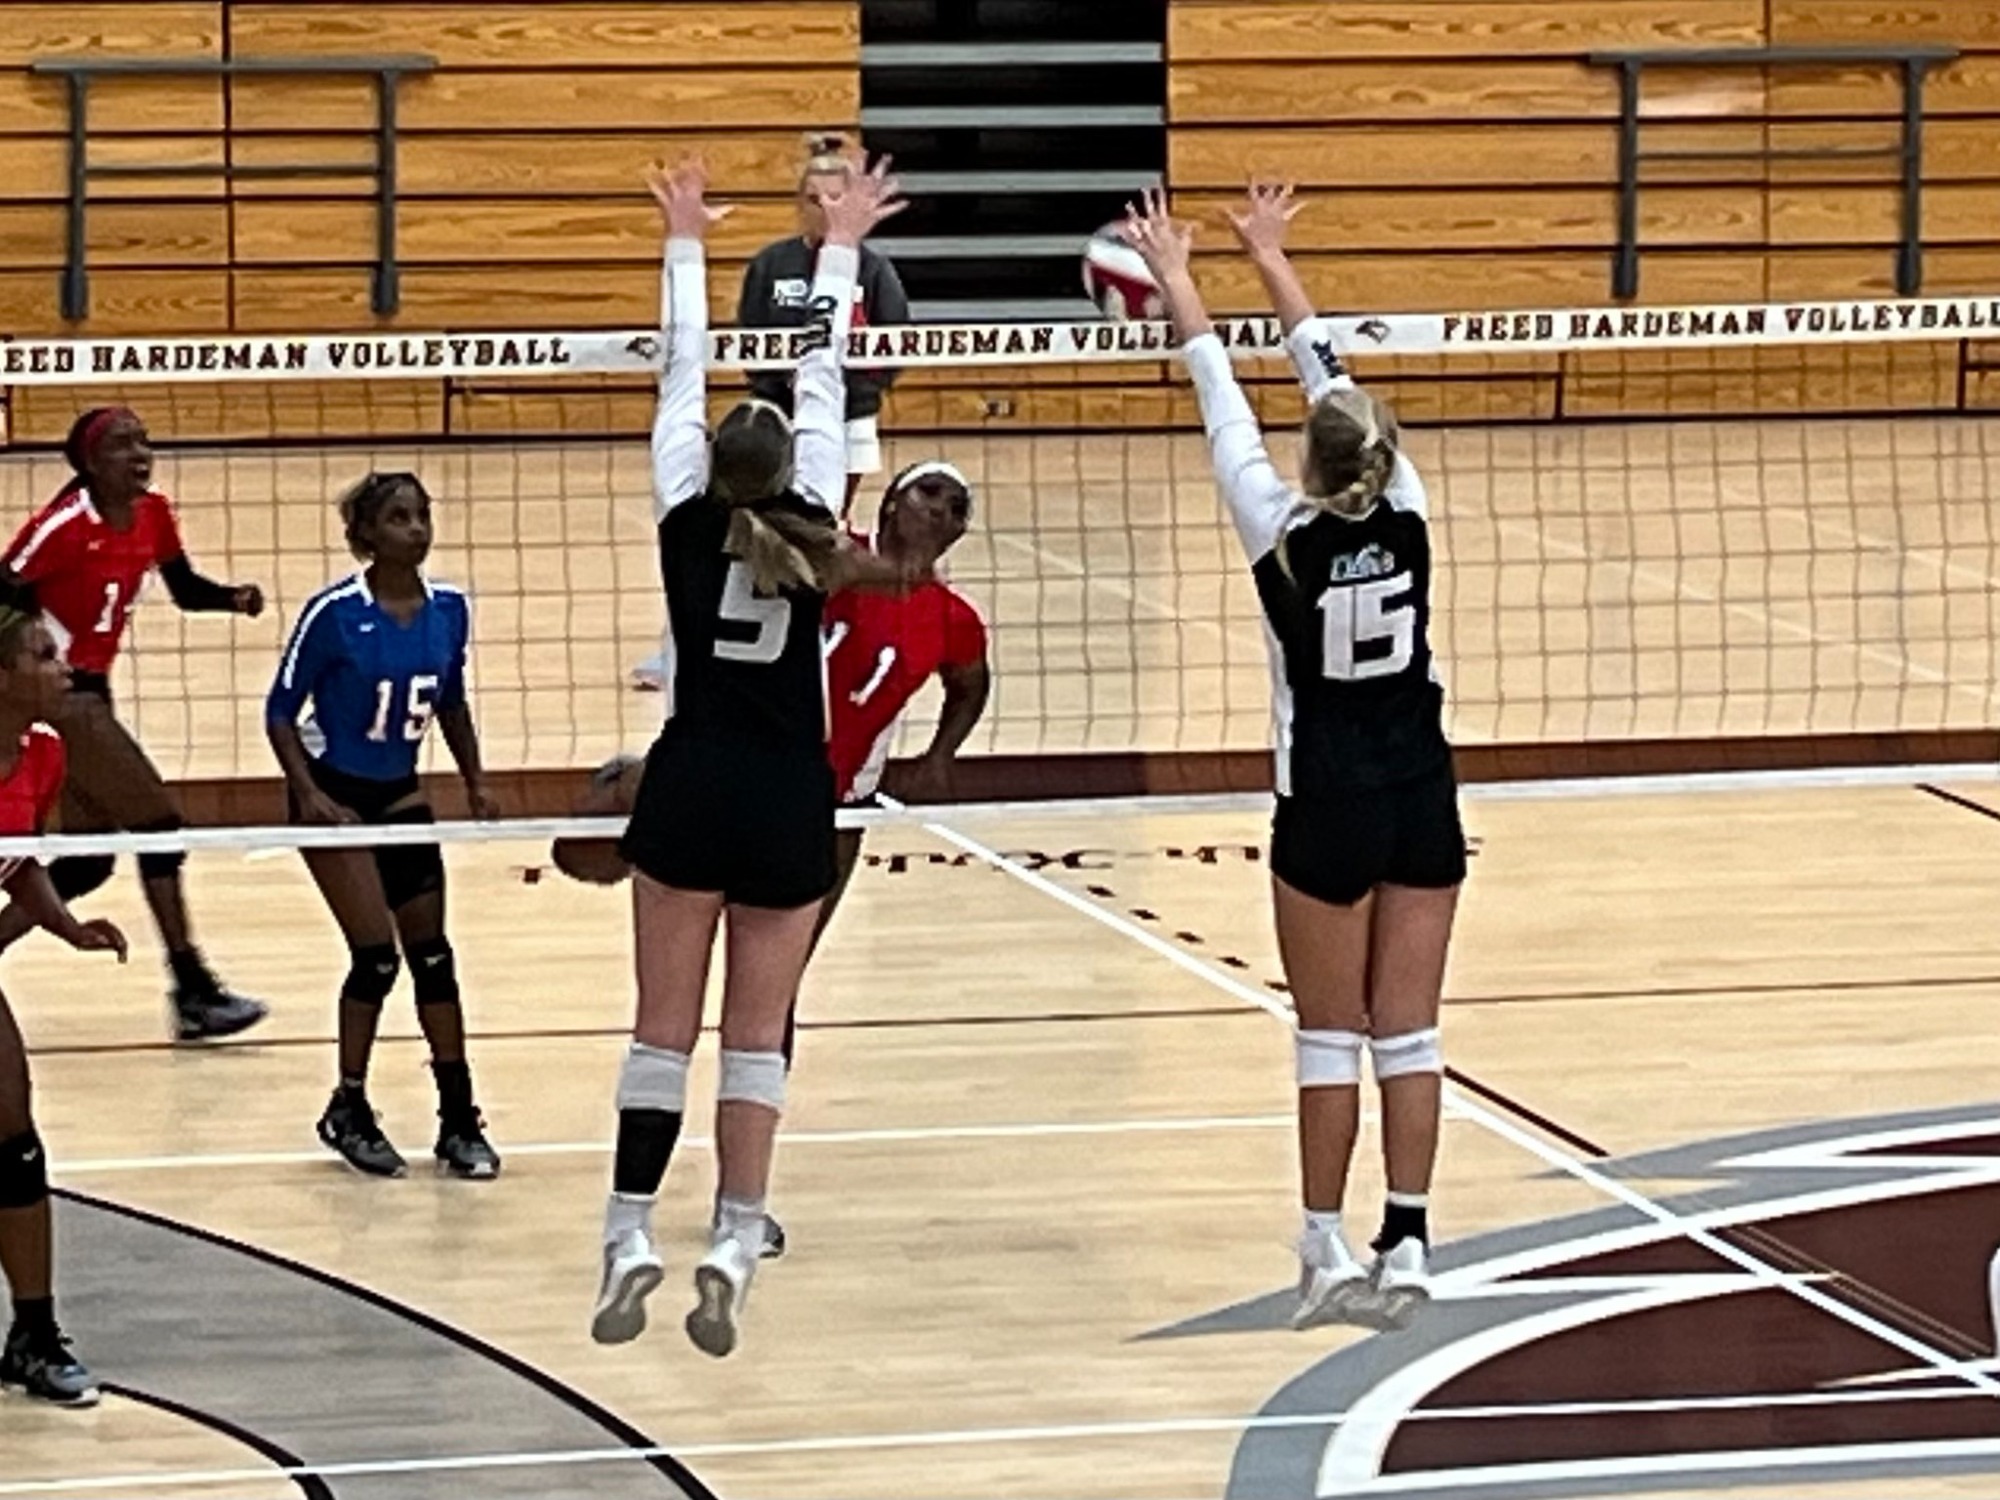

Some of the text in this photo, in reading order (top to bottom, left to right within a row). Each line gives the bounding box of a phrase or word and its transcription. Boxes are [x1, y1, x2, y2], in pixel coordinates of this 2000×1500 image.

[714, 332, 806, 362] FREE
[846, 326, 1054, 358] HARDEMAN
[1442, 313, 1554, 342] FREED
[1567, 309, 1766, 341] HARDEMAN
[3, 337, 571, 374] EED HARDEMAN VOLLEYBALL
[712, 560, 792, 664] 5
[1315, 569, 1417, 682] 15
[365, 674, 439, 742] 15
